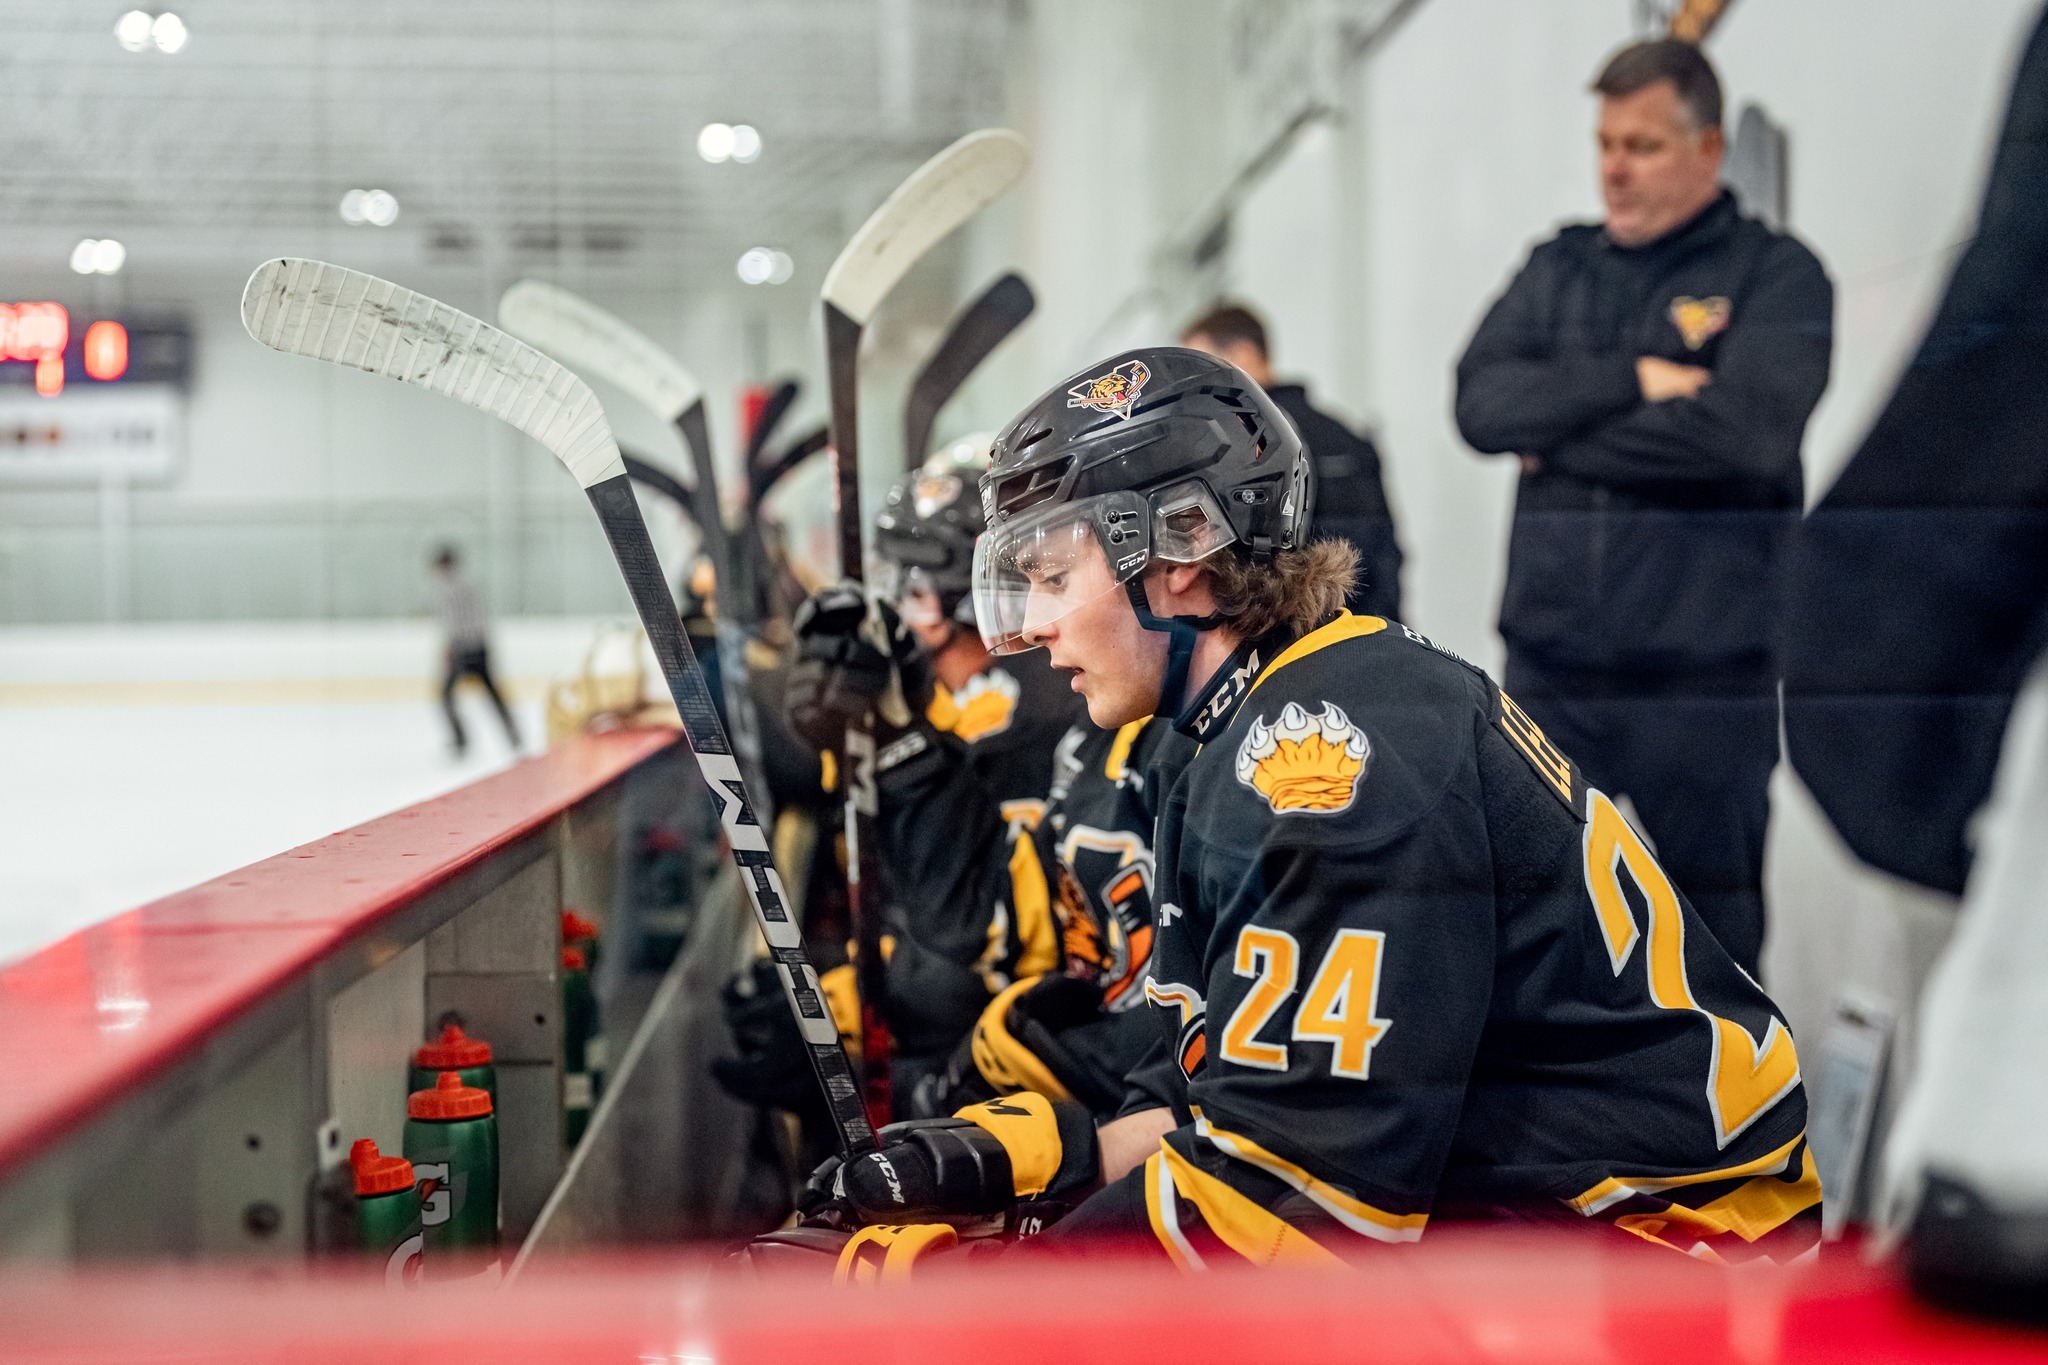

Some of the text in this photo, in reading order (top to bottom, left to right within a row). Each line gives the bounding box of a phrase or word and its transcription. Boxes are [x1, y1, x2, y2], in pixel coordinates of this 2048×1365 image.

[1120, 554, 1146, 571] CCM
[1190, 648, 1260, 736] CCM
[695, 752, 839, 1045] CCM
[1219, 923, 1393, 1081] 24
[1582, 787, 1801, 1151] 2
[868, 1152, 906, 1204] CCM
